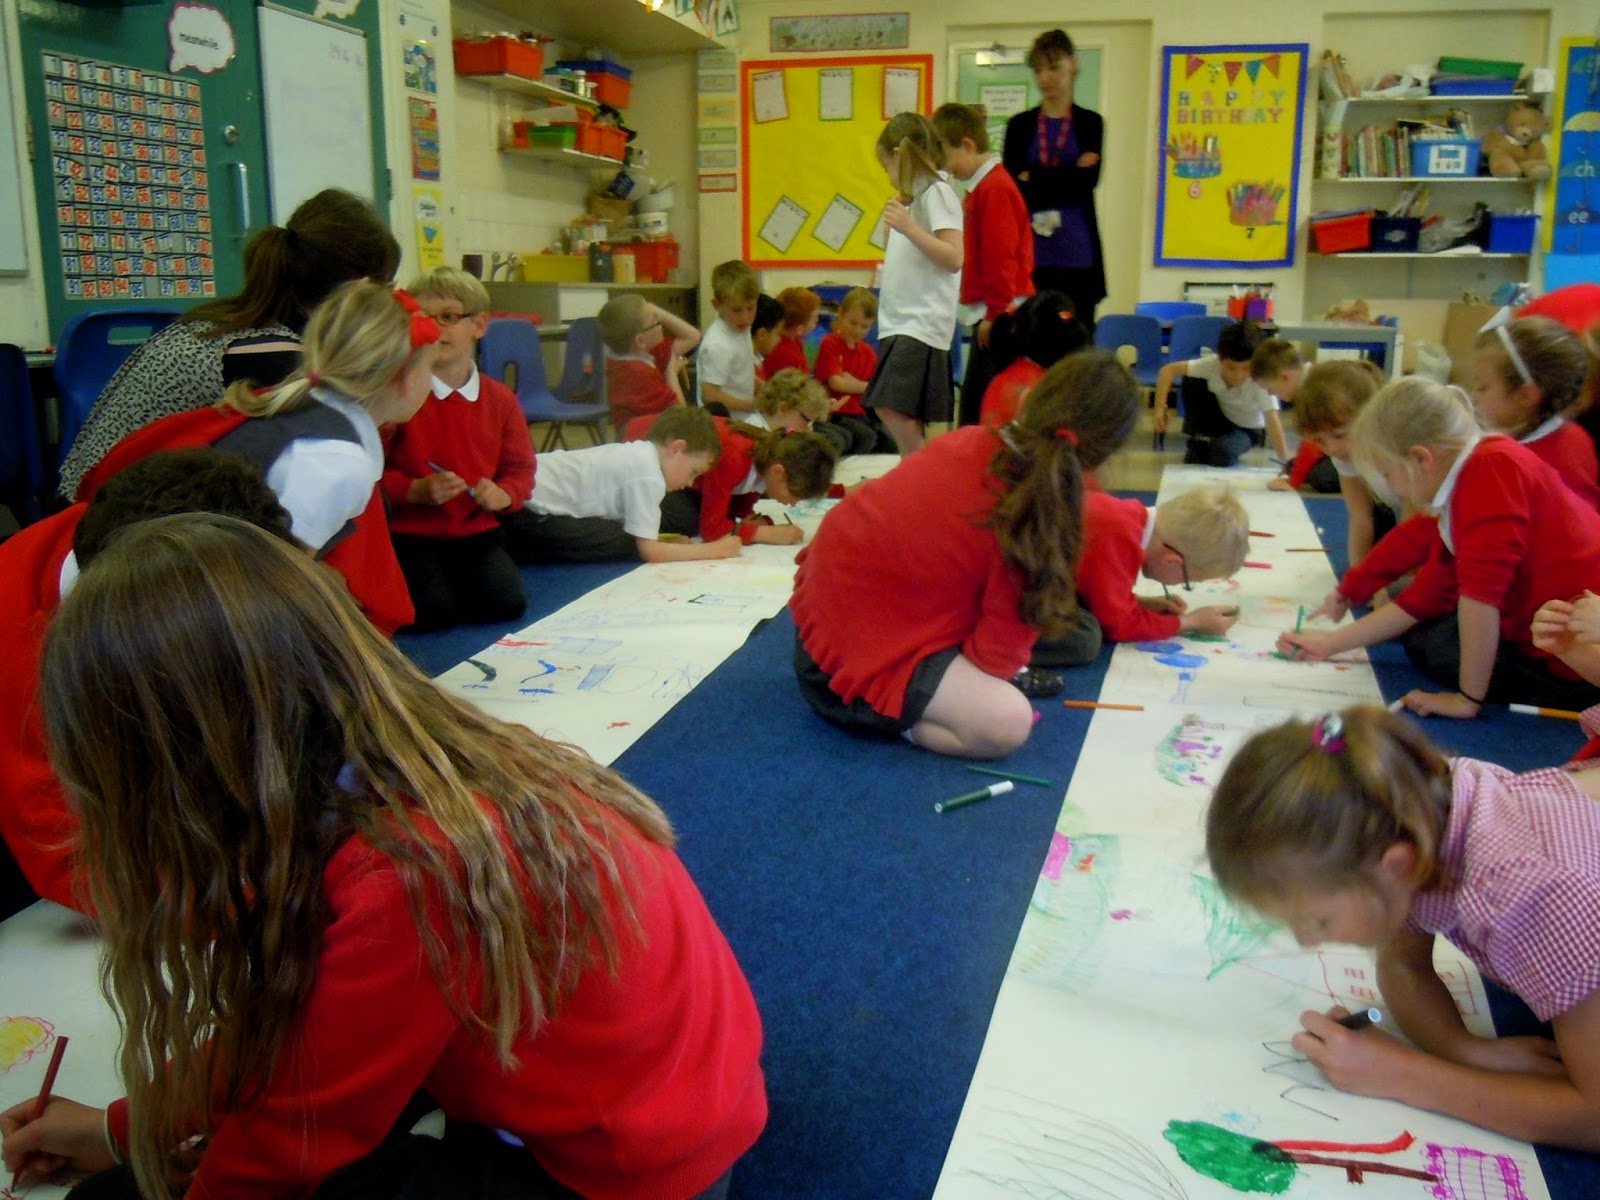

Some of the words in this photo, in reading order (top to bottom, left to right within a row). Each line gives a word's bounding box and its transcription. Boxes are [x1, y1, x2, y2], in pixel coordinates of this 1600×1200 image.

[1575, 160, 1595, 177] ch
[1189, 181, 1201, 199] 6
[1568, 211, 1589, 224] ee
[1246, 227, 1255, 239] 7
